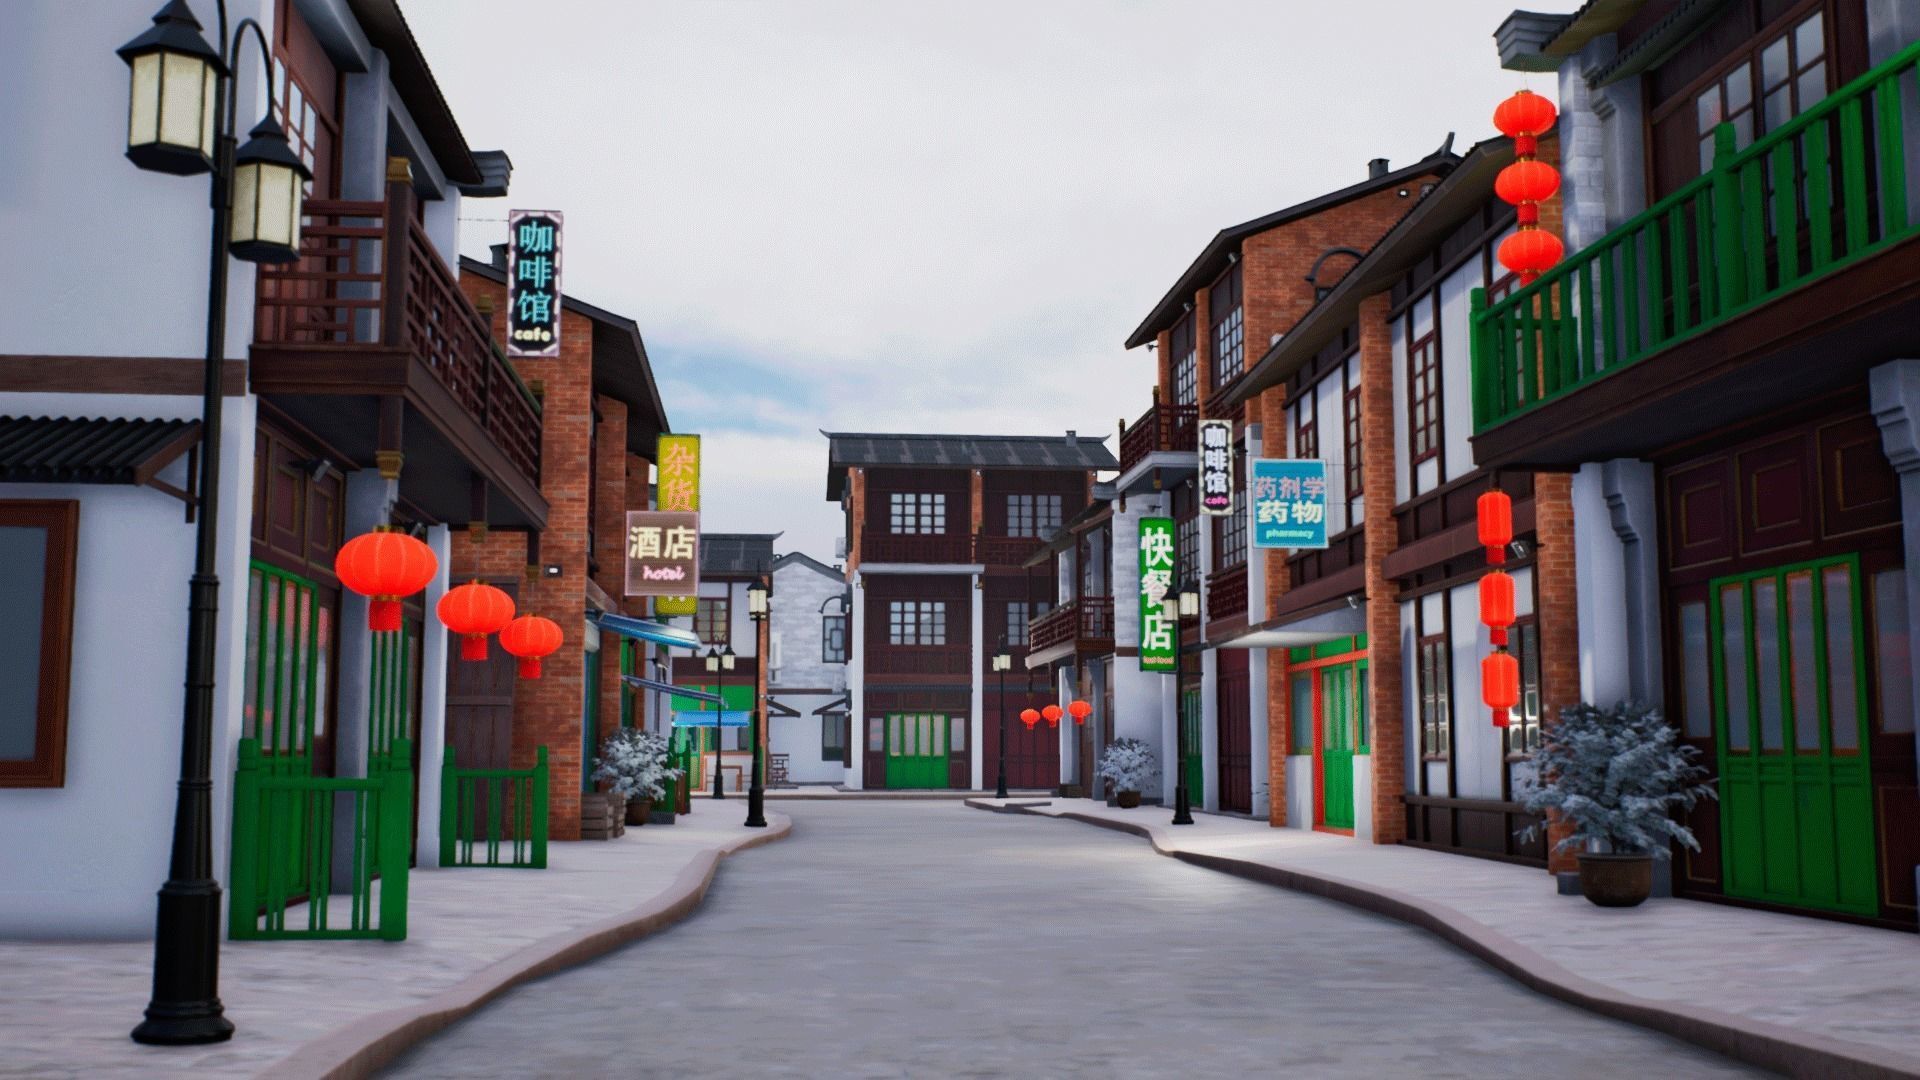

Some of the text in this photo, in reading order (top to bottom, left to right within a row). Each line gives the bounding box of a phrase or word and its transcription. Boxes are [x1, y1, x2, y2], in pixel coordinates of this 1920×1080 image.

[518, 220, 553, 323] 咖啡馆
[514, 327, 551, 342] cafe
[1205, 425, 1228, 494] 咖啡馆
[1255, 476, 1325, 500] 药剂学
[1257, 500, 1323, 525] 药物
[629, 525, 696, 560] 酒店
[1265, 529, 1314, 540] pharmacy
[643, 565, 686, 581] hotel
[1140, 527, 1174, 650] 快餐店
